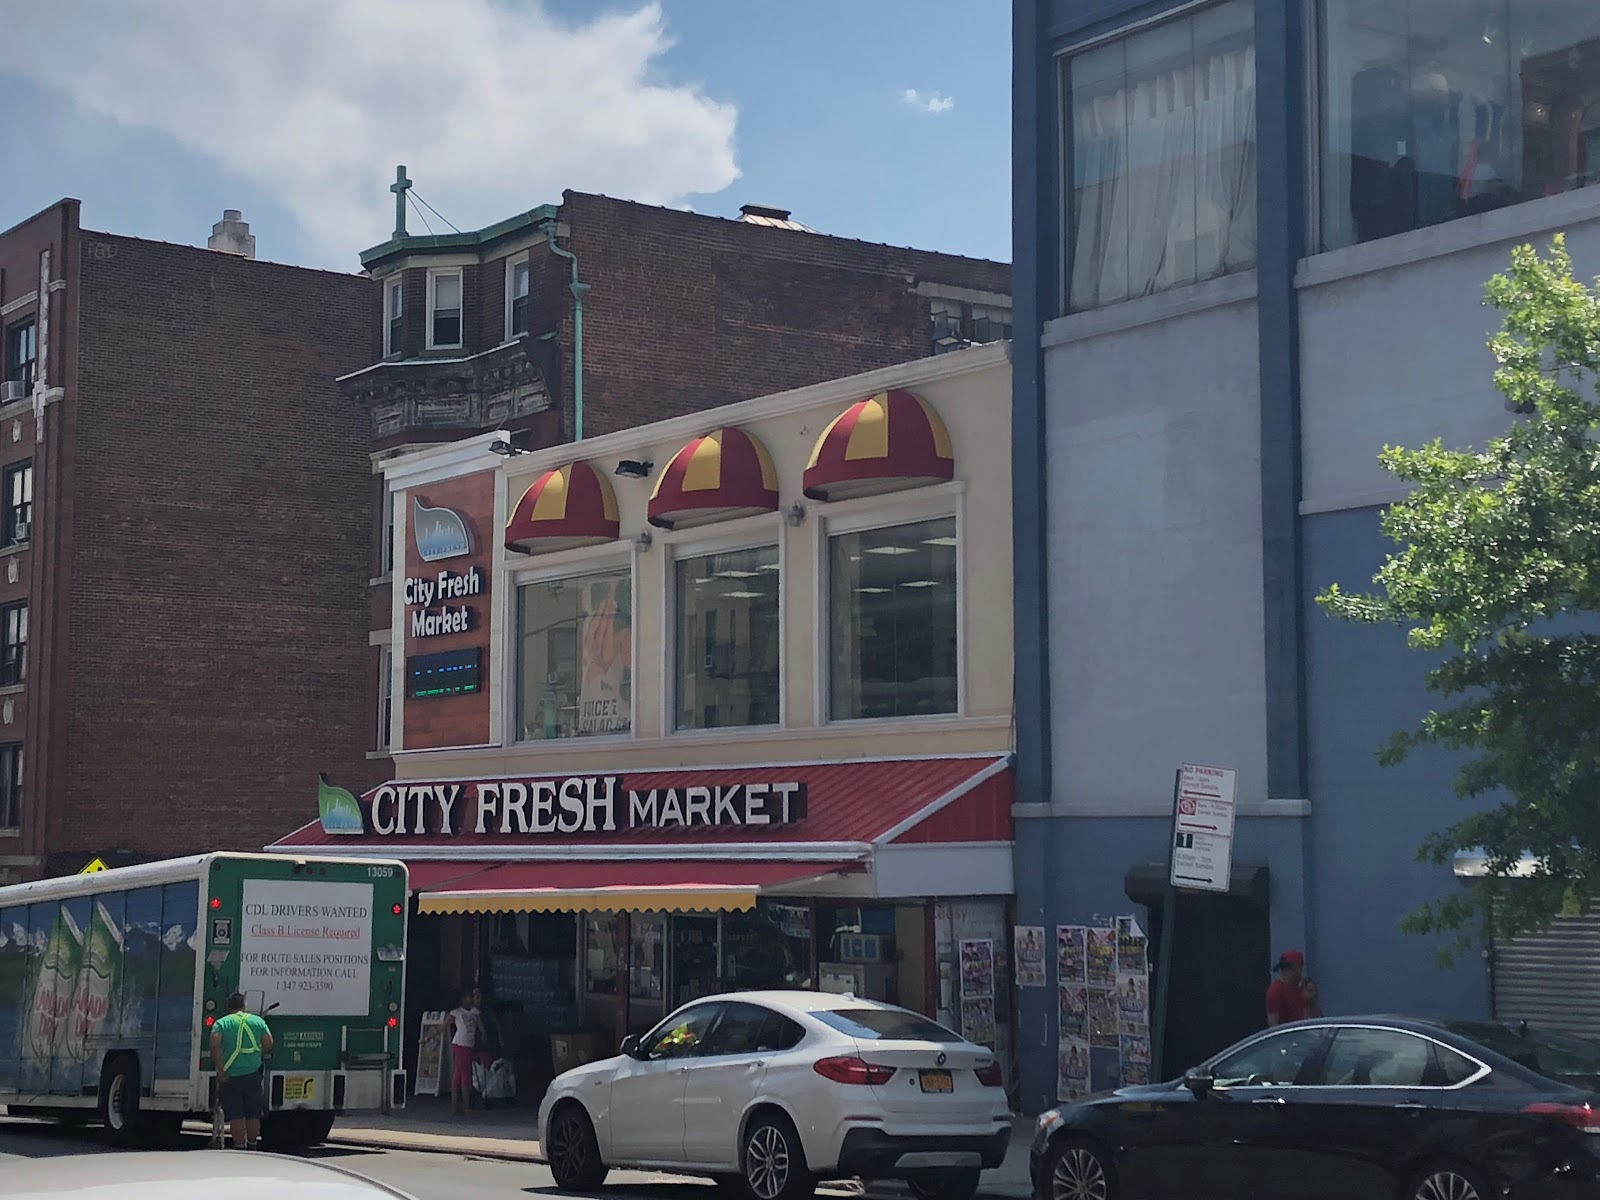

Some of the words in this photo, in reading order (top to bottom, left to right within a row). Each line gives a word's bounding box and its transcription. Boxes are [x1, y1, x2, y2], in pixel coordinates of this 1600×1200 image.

[404, 577, 434, 607] City
[438, 566, 479, 600] Fresh
[411, 605, 468, 638] Market
[371, 784, 460, 836] CITY
[474, 777, 617, 834] FRESH
[628, 782, 799, 828] MARKET
[366, 866, 393, 878] 13059
[245, 903, 268, 916] CDL
[271, 904, 319, 917] DRIVERS
[321, 906, 367, 918] WANTED
[251, 924, 275, 936] Class
[278, 925, 284, 936] B
[287, 925, 320, 936] License
[322, 926, 360, 939] Required
[240, 952, 258, 963] FOR
[261, 953, 291, 964] ROUTE
[293, 953, 321, 964] SALES
[323, 954, 368, 965] POSITIONS
[250, 967, 268, 977] FOR
[270, 967, 333, 978] INFORMATION
[334, 968, 358, 978] CALL
[282, 981, 296, 991] 347
[298, 981, 333, 991] 923-3590
